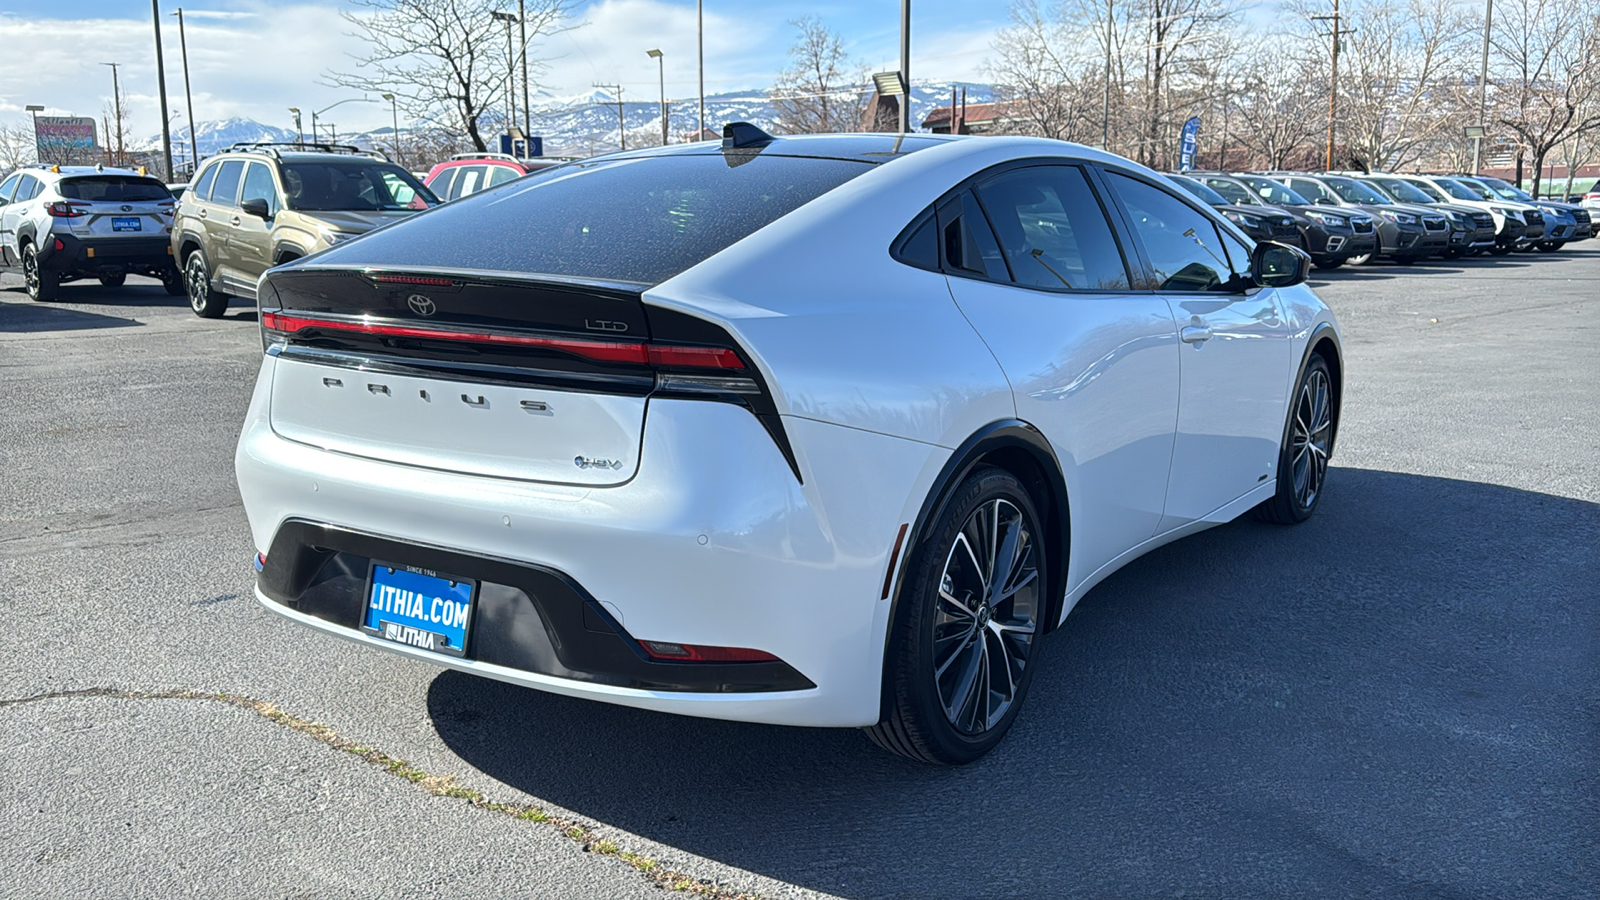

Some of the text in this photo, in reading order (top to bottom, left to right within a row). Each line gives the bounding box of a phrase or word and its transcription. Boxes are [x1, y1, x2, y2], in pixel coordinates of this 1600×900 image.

[584, 319, 629, 332] LTD
[322, 377, 547, 411] PRIUS
[406, 565, 437, 578] SINCE 1946
[370, 582, 469, 630] LITHIA.COM
[396, 625, 435, 650] LITHIA
